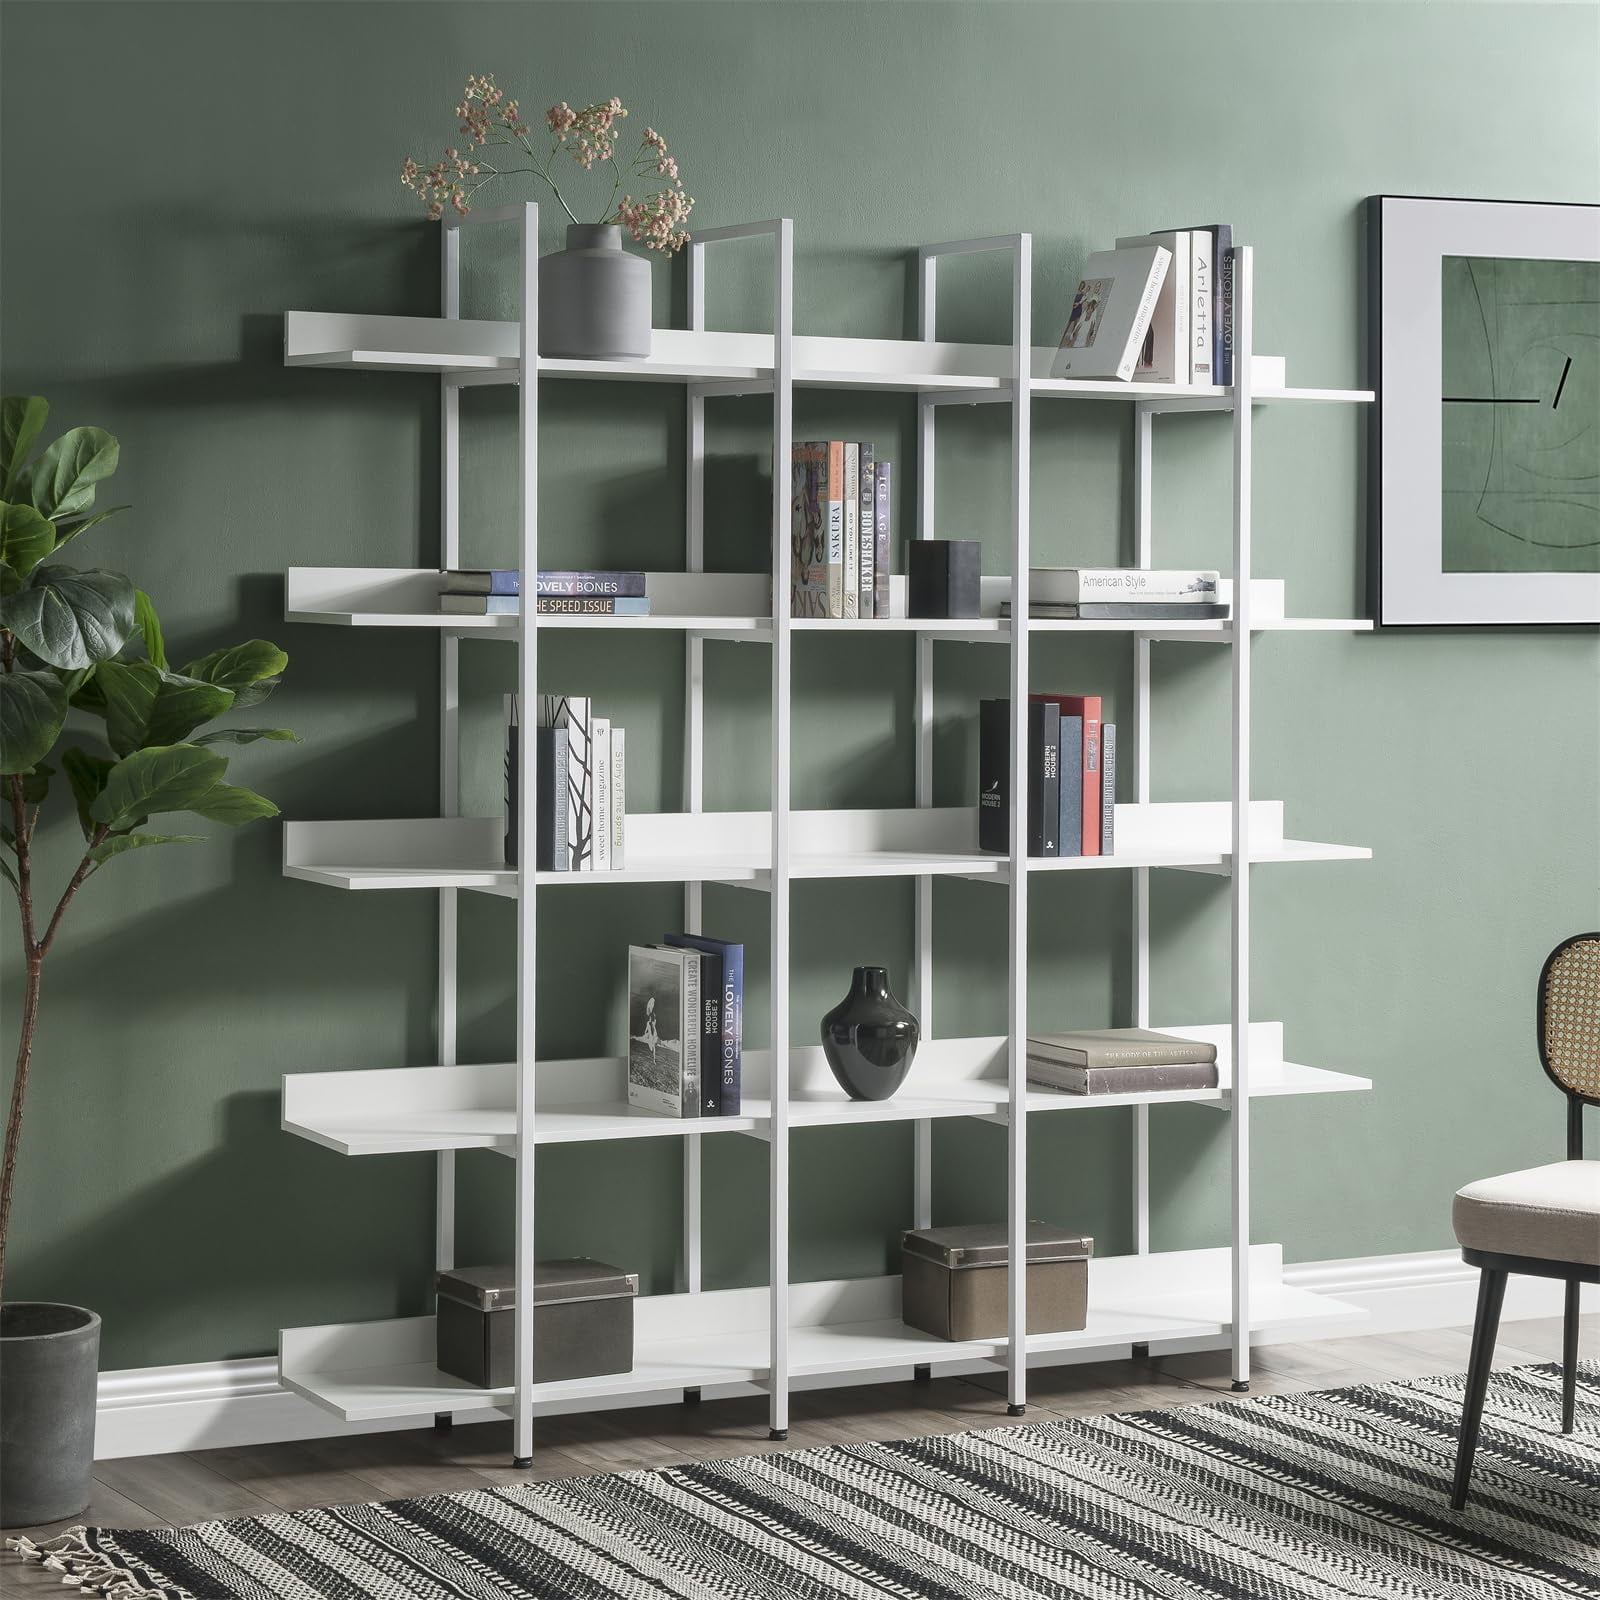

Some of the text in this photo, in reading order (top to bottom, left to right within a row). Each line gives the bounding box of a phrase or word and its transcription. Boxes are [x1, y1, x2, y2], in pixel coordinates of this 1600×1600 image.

[1197, 256, 1208, 347] Arletta
[1223, 255, 1232, 364] THE LOVELY BONES
[879, 476, 887, 542] ICE AGE
[831, 507, 840, 558] SAKURA
[861, 510, 873, 593] BONESHAKER
[536, 581, 574, 592] OVELY
[576, 581, 618, 593] BONES
[1083, 575, 1146, 589] American Style
[537, 599, 613, 613] HE SPEED ISSUE
[596, 760, 607, 804] magazine
[597, 806, 605, 832] home
[687, 960, 697, 988] CREATE
[724, 984, 734, 1036] LOVELY
[724, 1039, 734, 1085] BONES
